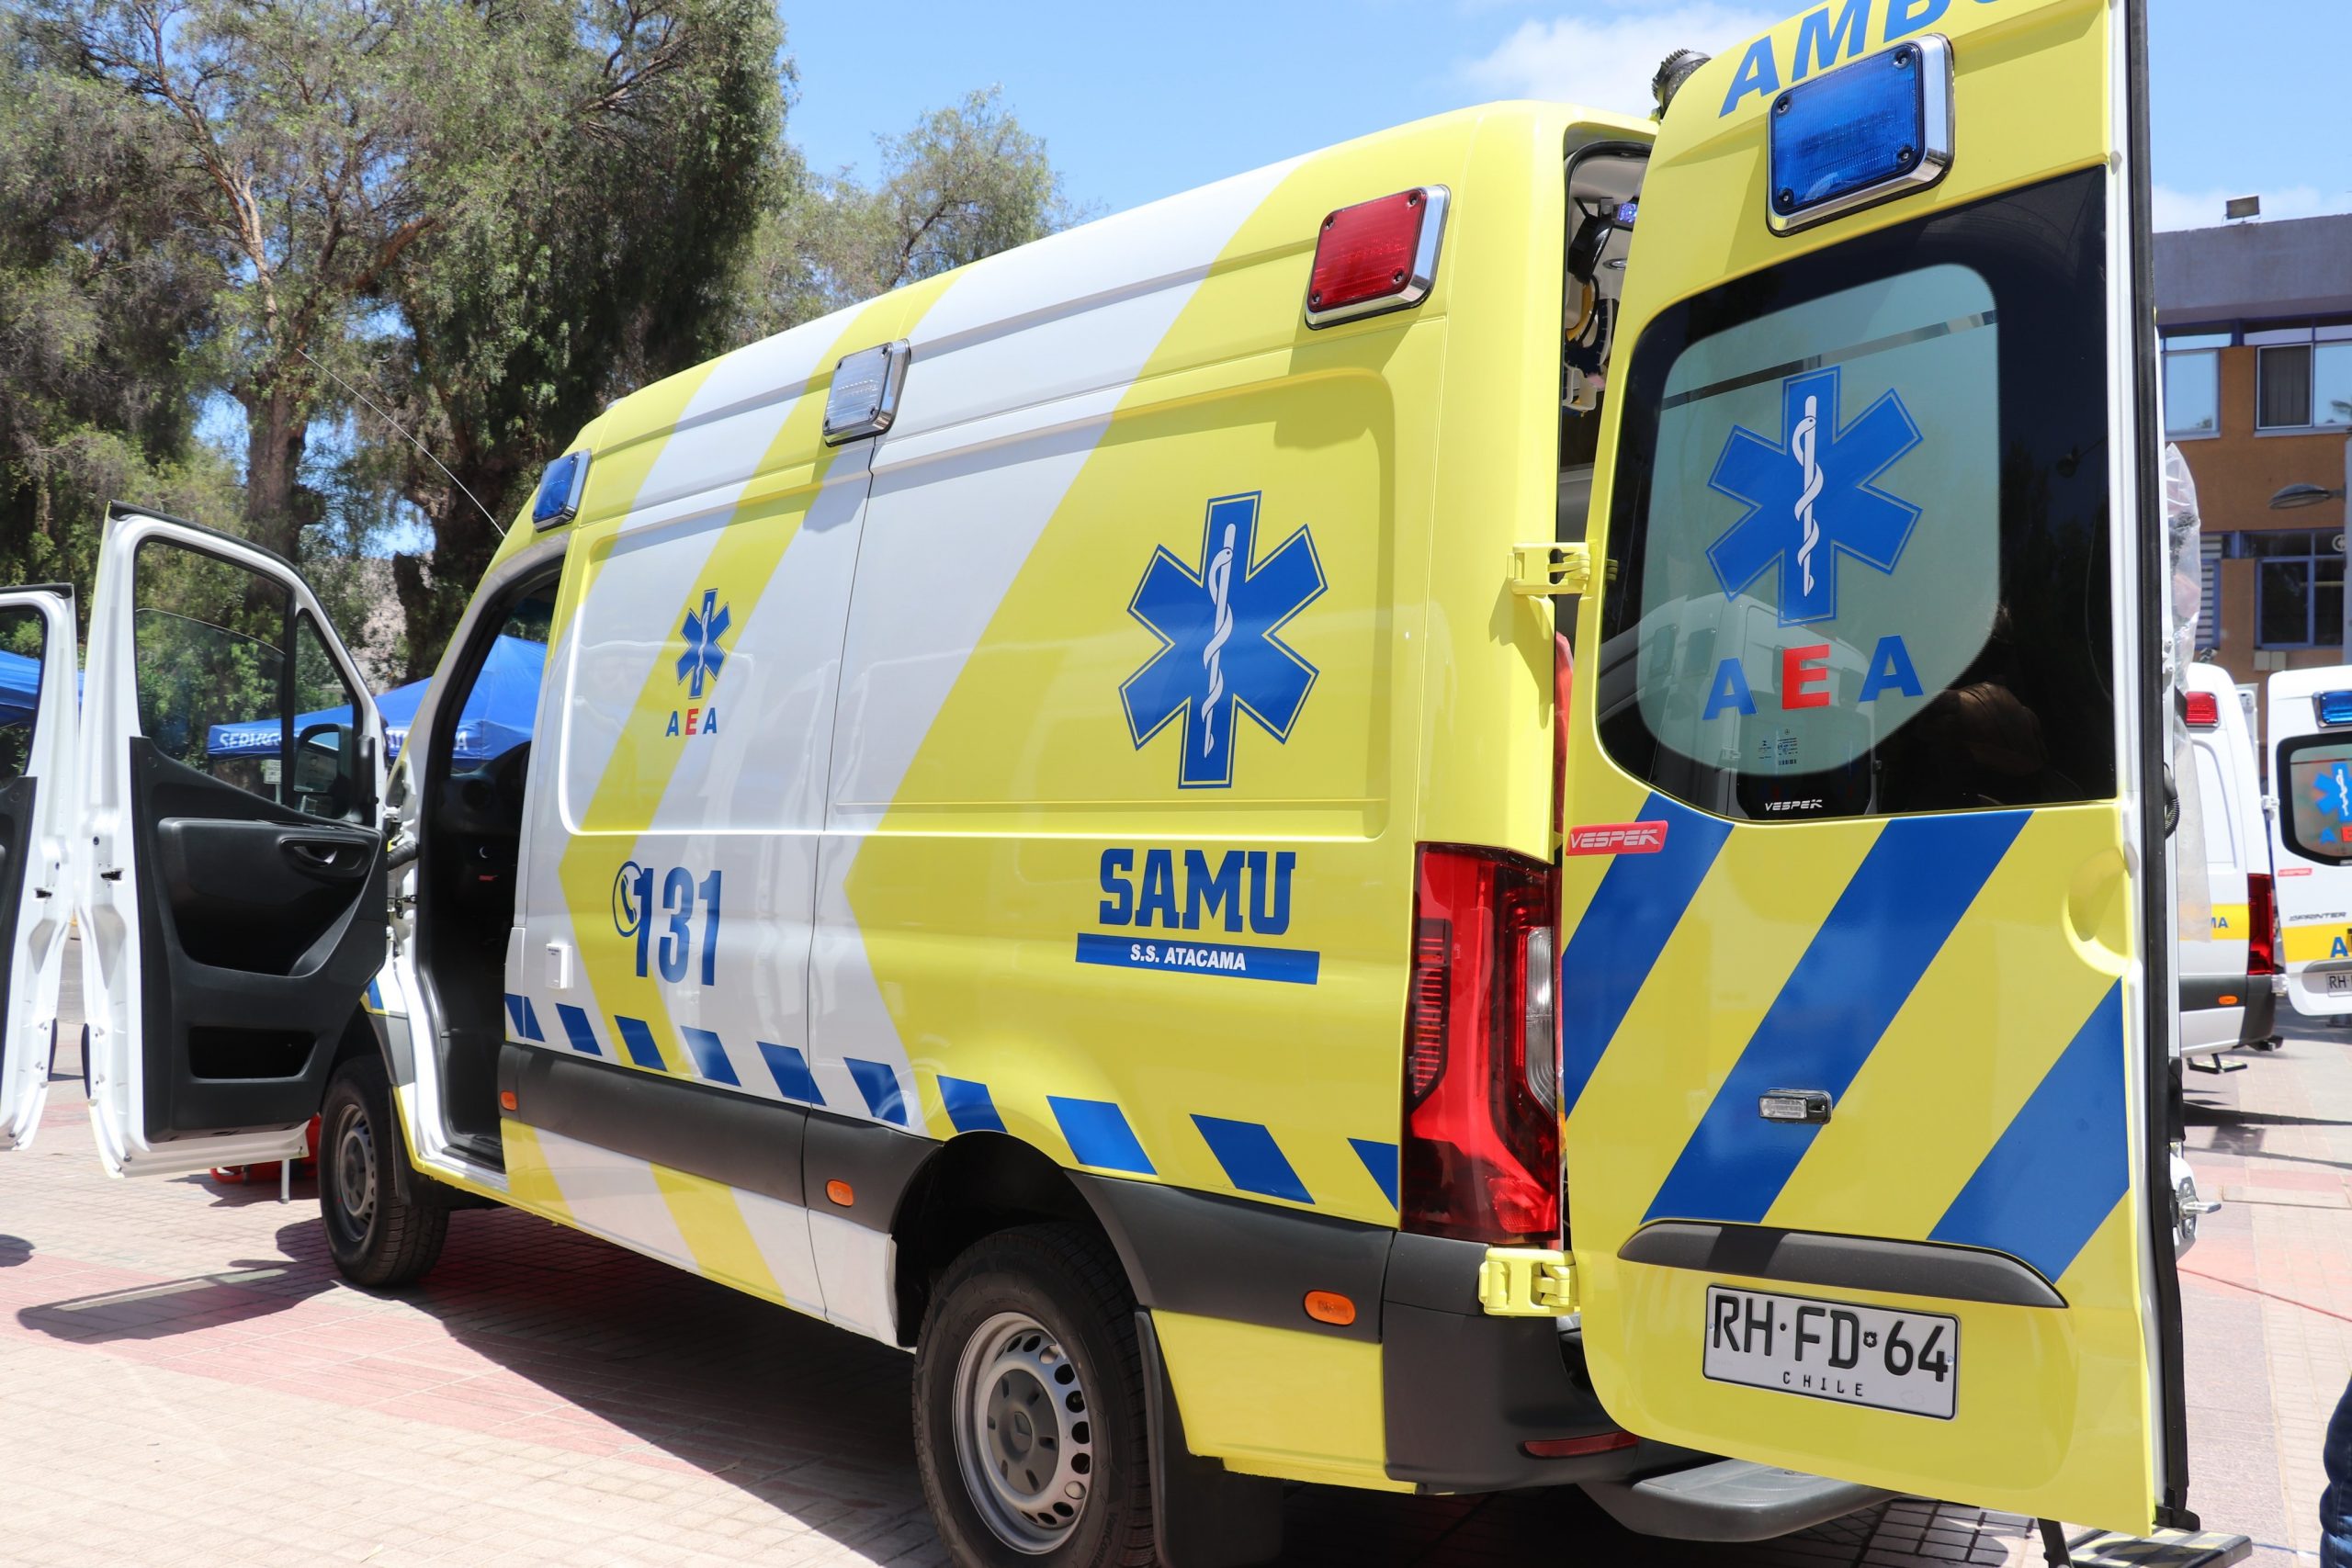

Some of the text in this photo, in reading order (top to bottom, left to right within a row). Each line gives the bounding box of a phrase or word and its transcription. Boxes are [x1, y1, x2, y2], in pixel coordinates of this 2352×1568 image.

[664, 707, 718, 737] AEA
[1765, 799, 1823, 811] VESPEK
[1570, 829, 1660, 849] VESPEK
[1099, 848, 1296, 935] SAMU
[632, 866, 722, 987] 131
[1130, 943, 1247, 971] S.S. ATACAMA
[1782, 1371, 1863, 1397] CHILE
[1089, 1511, 1120, 1568] VanConta
